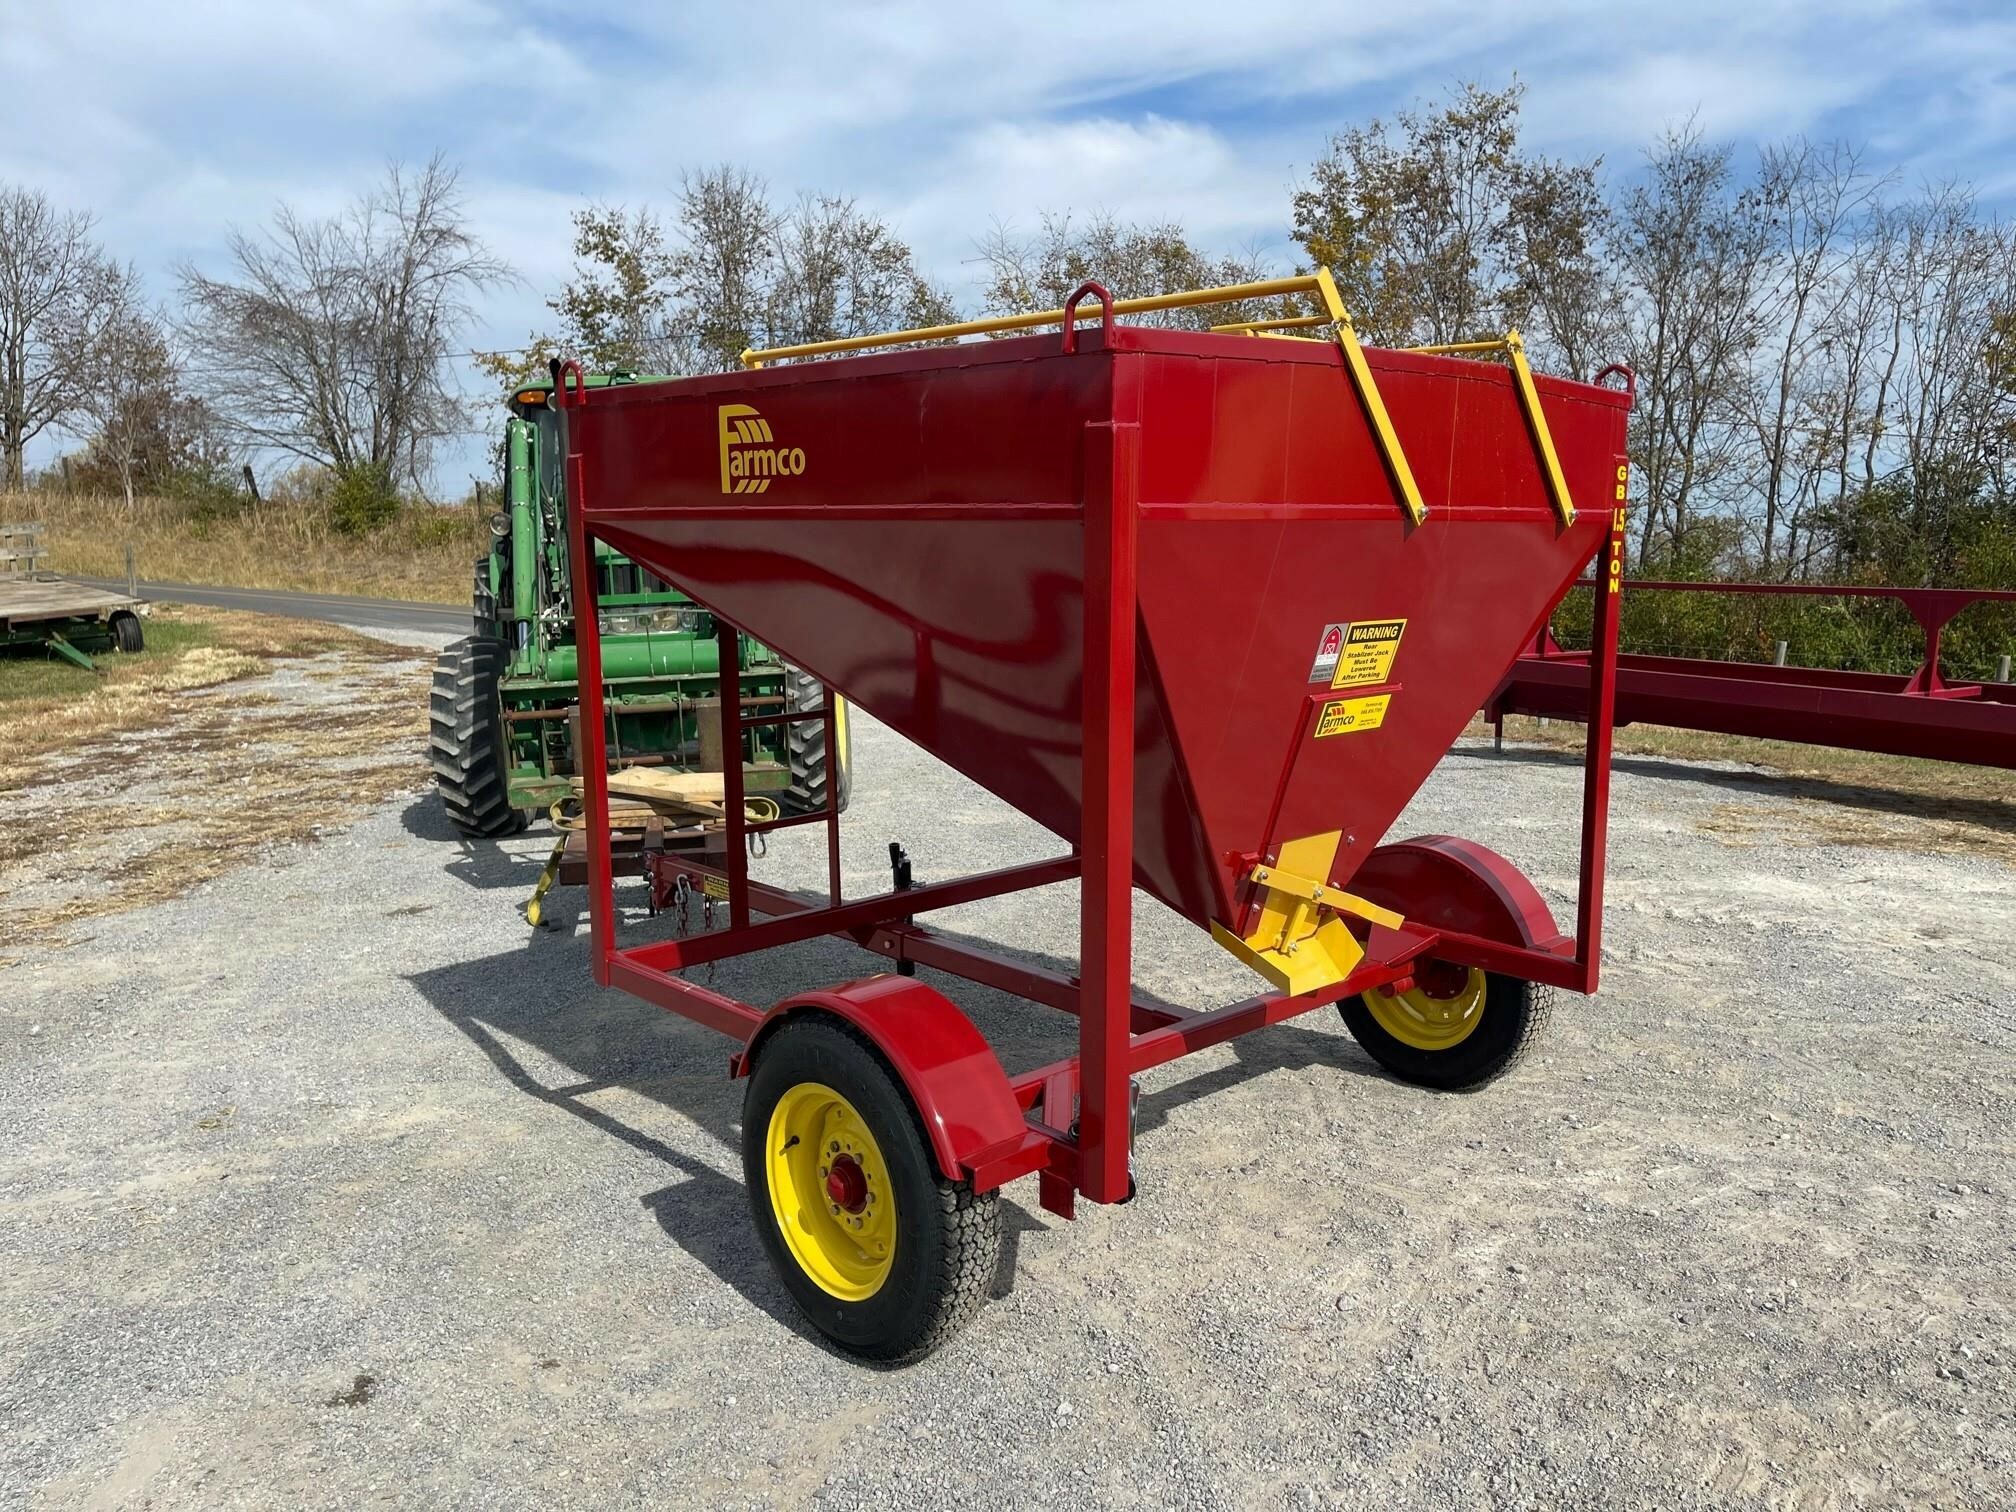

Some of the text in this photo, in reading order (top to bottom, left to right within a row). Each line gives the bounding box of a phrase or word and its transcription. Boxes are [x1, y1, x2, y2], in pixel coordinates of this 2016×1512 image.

[718, 403, 806, 494] Farmco
[1613, 507, 1625, 532] 1.5
[1609, 540, 1622, 593] TON
[1352, 625, 1399, 640] WARNING
[1374, 649, 1389, 657] Jack
[1350, 664, 1377, 673] Lowered
[1357, 671, 1381, 680] Parking
[1317, 702, 1355, 736] Farmco
